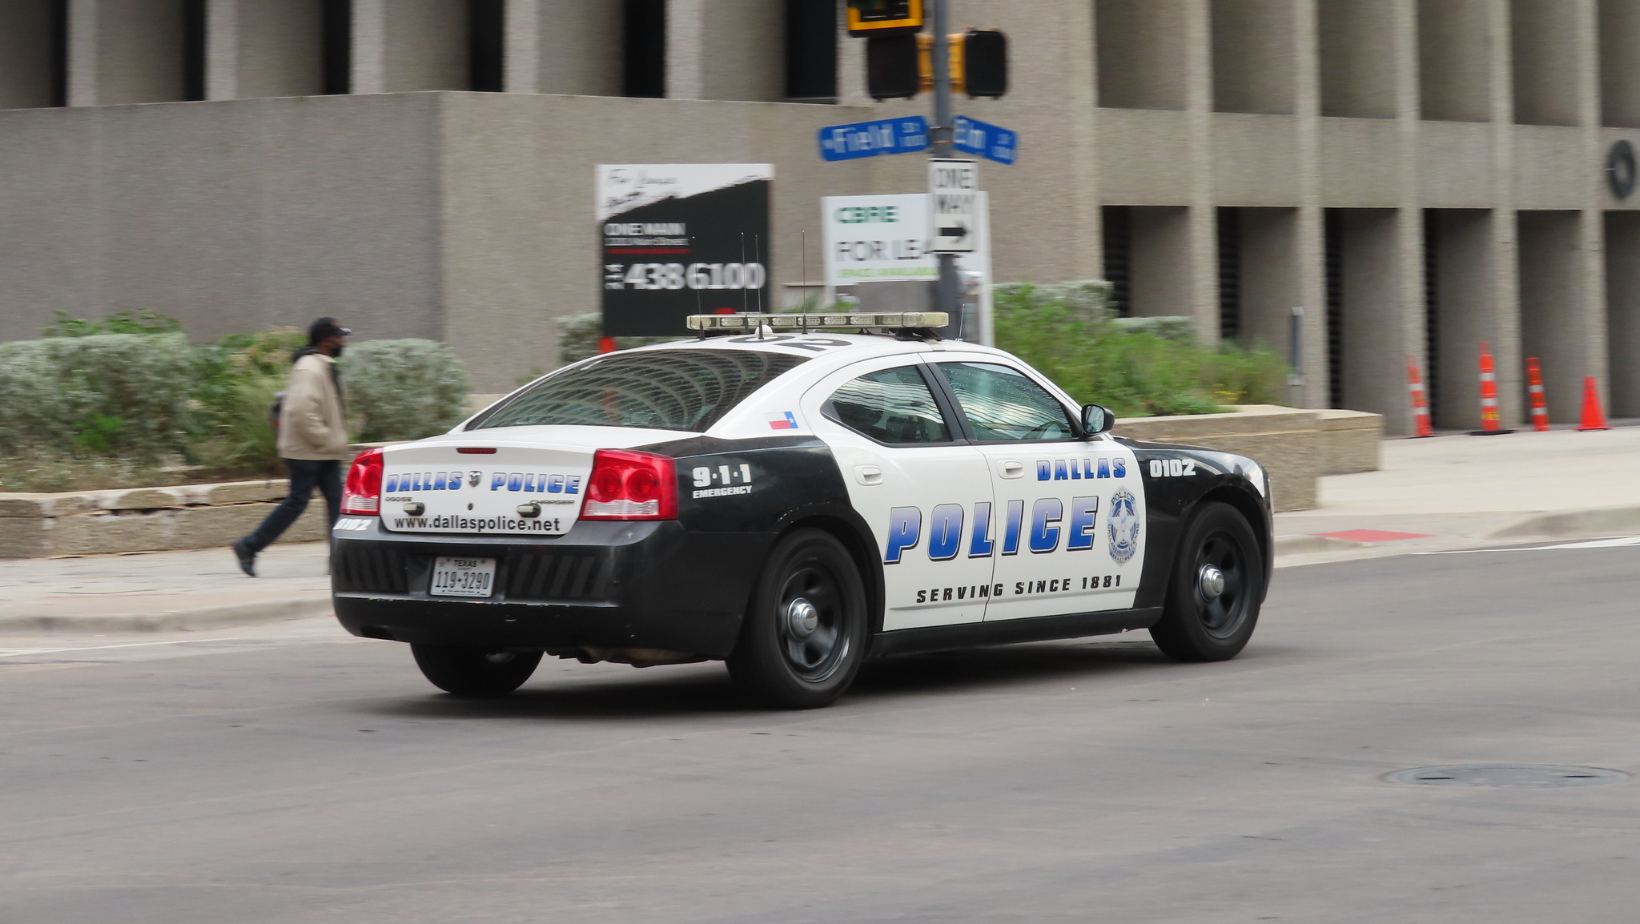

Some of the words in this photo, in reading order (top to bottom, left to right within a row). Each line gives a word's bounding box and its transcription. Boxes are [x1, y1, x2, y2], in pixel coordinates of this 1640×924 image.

[832, 123, 895, 154] Field
[933, 167, 976, 190] ONE
[834, 205, 900, 224] CBRE
[934, 193, 976, 215] WAY
[604, 223, 643, 235] ONE
[643, 223, 687, 235] MAIN
[834, 240, 889, 262] FOR
[892, 239, 931, 260] LEA
[624, 262, 686, 290] 438
[685, 262, 767, 290] 6100
[1036, 457, 1127, 481] DALLAS
[1149, 458, 1197, 478] 0102
[385, 471, 464, 493] DALLAS
[490, 472, 582, 495] POLICE
[692, 485, 753, 499] EMERGENCY
[1111, 491, 1136, 505] POLICE
[333, 517, 373, 532] 0102
[394, 514, 561, 533] www.dallaspolice.net
[884, 495, 1100, 565] POLICE
[453, 559, 478, 567] TEXAS
[916, 583, 1004, 604] SERVING
[1014, 578, 1072, 596] SINCE
[1081, 574, 1122, 591] 1881
